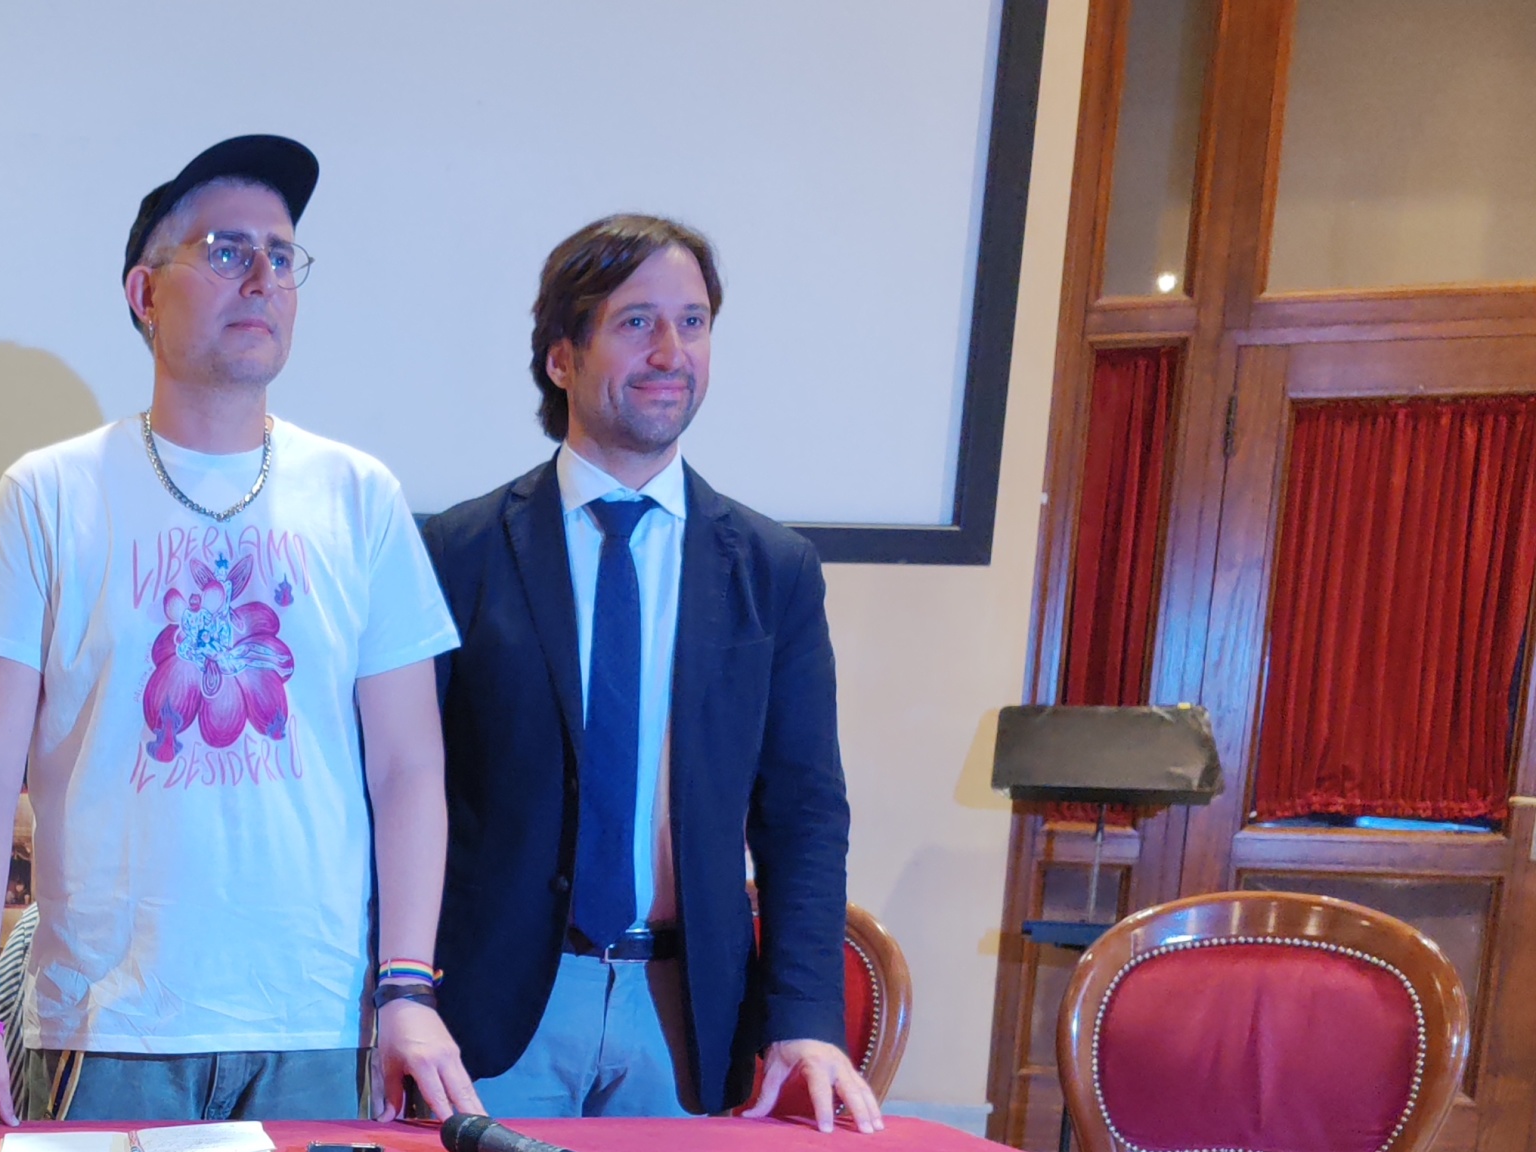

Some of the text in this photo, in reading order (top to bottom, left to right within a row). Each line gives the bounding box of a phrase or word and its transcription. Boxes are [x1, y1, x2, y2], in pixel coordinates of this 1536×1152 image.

[133, 526, 310, 609] LIBERIAMO
[130, 714, 302, 793] IL DESIDERIO
